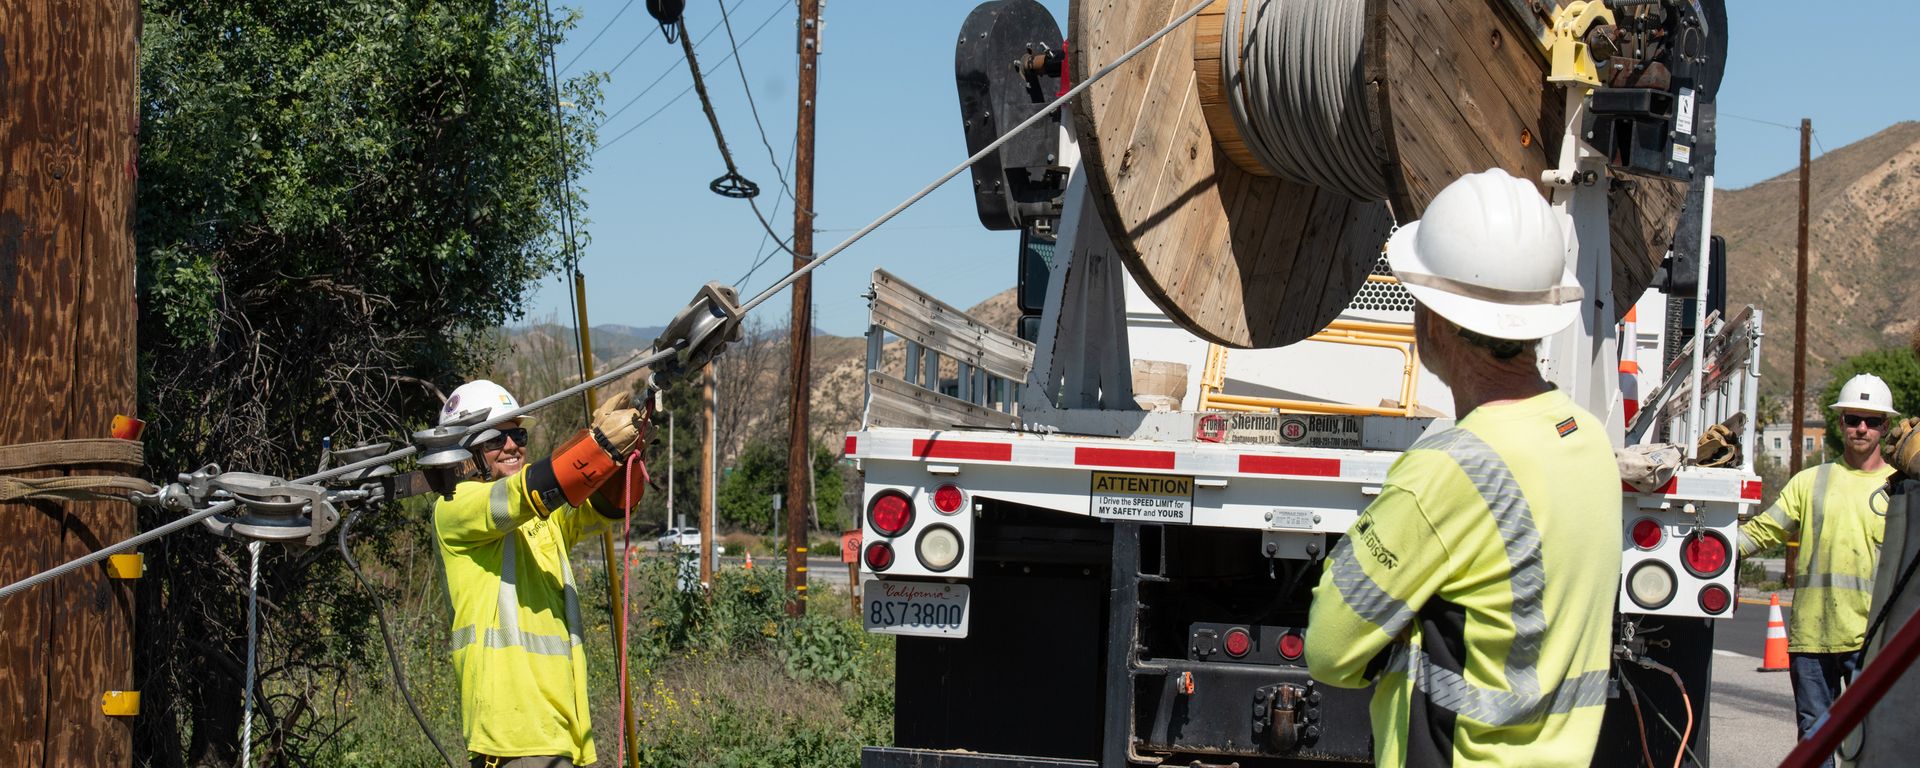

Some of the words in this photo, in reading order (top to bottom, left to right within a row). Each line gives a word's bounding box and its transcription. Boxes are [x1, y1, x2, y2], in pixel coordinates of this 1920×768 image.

[1232, 414, 1278, 431] Sherman
[1287, 425, 1300, 437] SR
[1096, 476, 1188, 494] ATTENTION
[1103, 497, 1120, 505] Drive
[1121, 498, 1132, 506] the
[1132, 498, 1154, 506] SPEED
[1155, 500, 1173, 508] LIMIT
[1174, 500, 1184, 508] for
[1112, 507, 1142, 516] SAFETY
[1143, 509, 1156, 517] and
[1157, 509, 1184, 518] YOURS
[1364, 532, 1394, 570] EDISON
[886, 585, 945, 601] California
[871, 600, 961, 629] 8S73800
